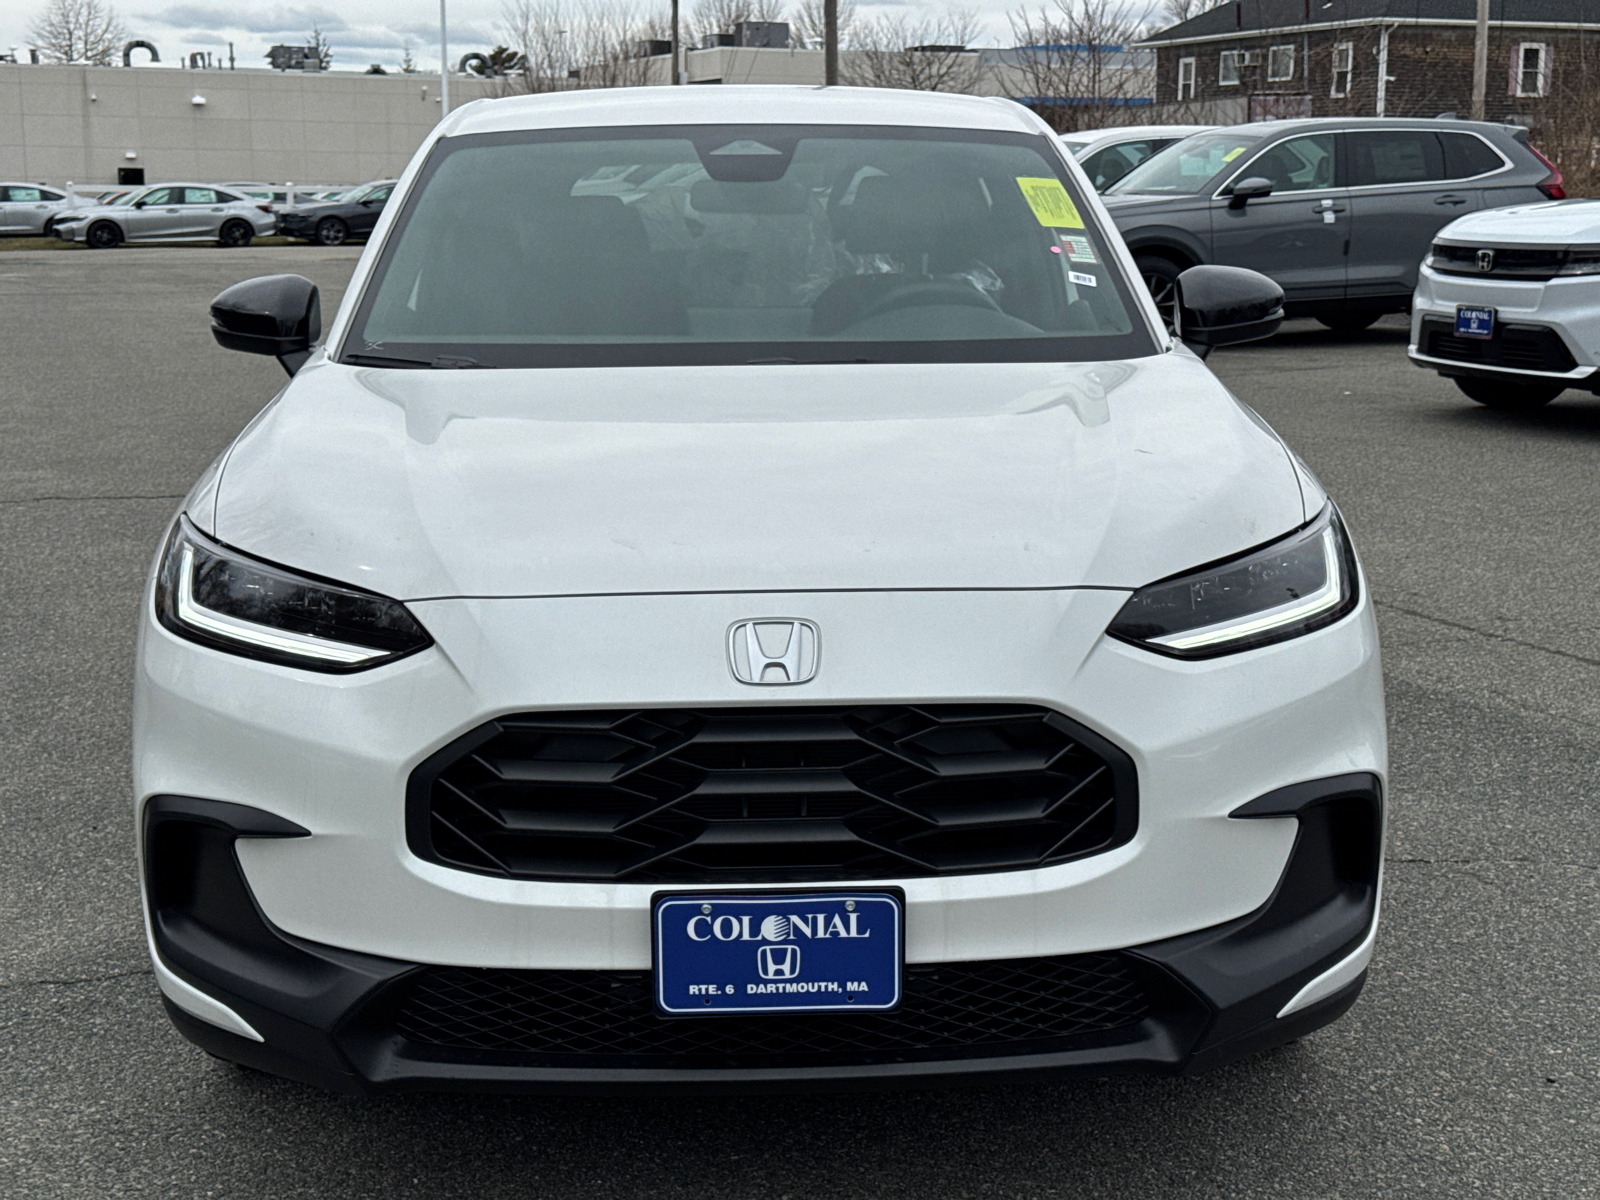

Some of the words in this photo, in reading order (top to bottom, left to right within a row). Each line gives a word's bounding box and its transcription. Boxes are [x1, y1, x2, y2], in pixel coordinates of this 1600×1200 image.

[686, 912, 871, 942] COLONIAL
[688, 984, 722, 995] RTE.
[725, 984, 735, 995] 6
[746, 981, 843, 994] DARTMOUTH,
[846, 981, 869, 992] MA
